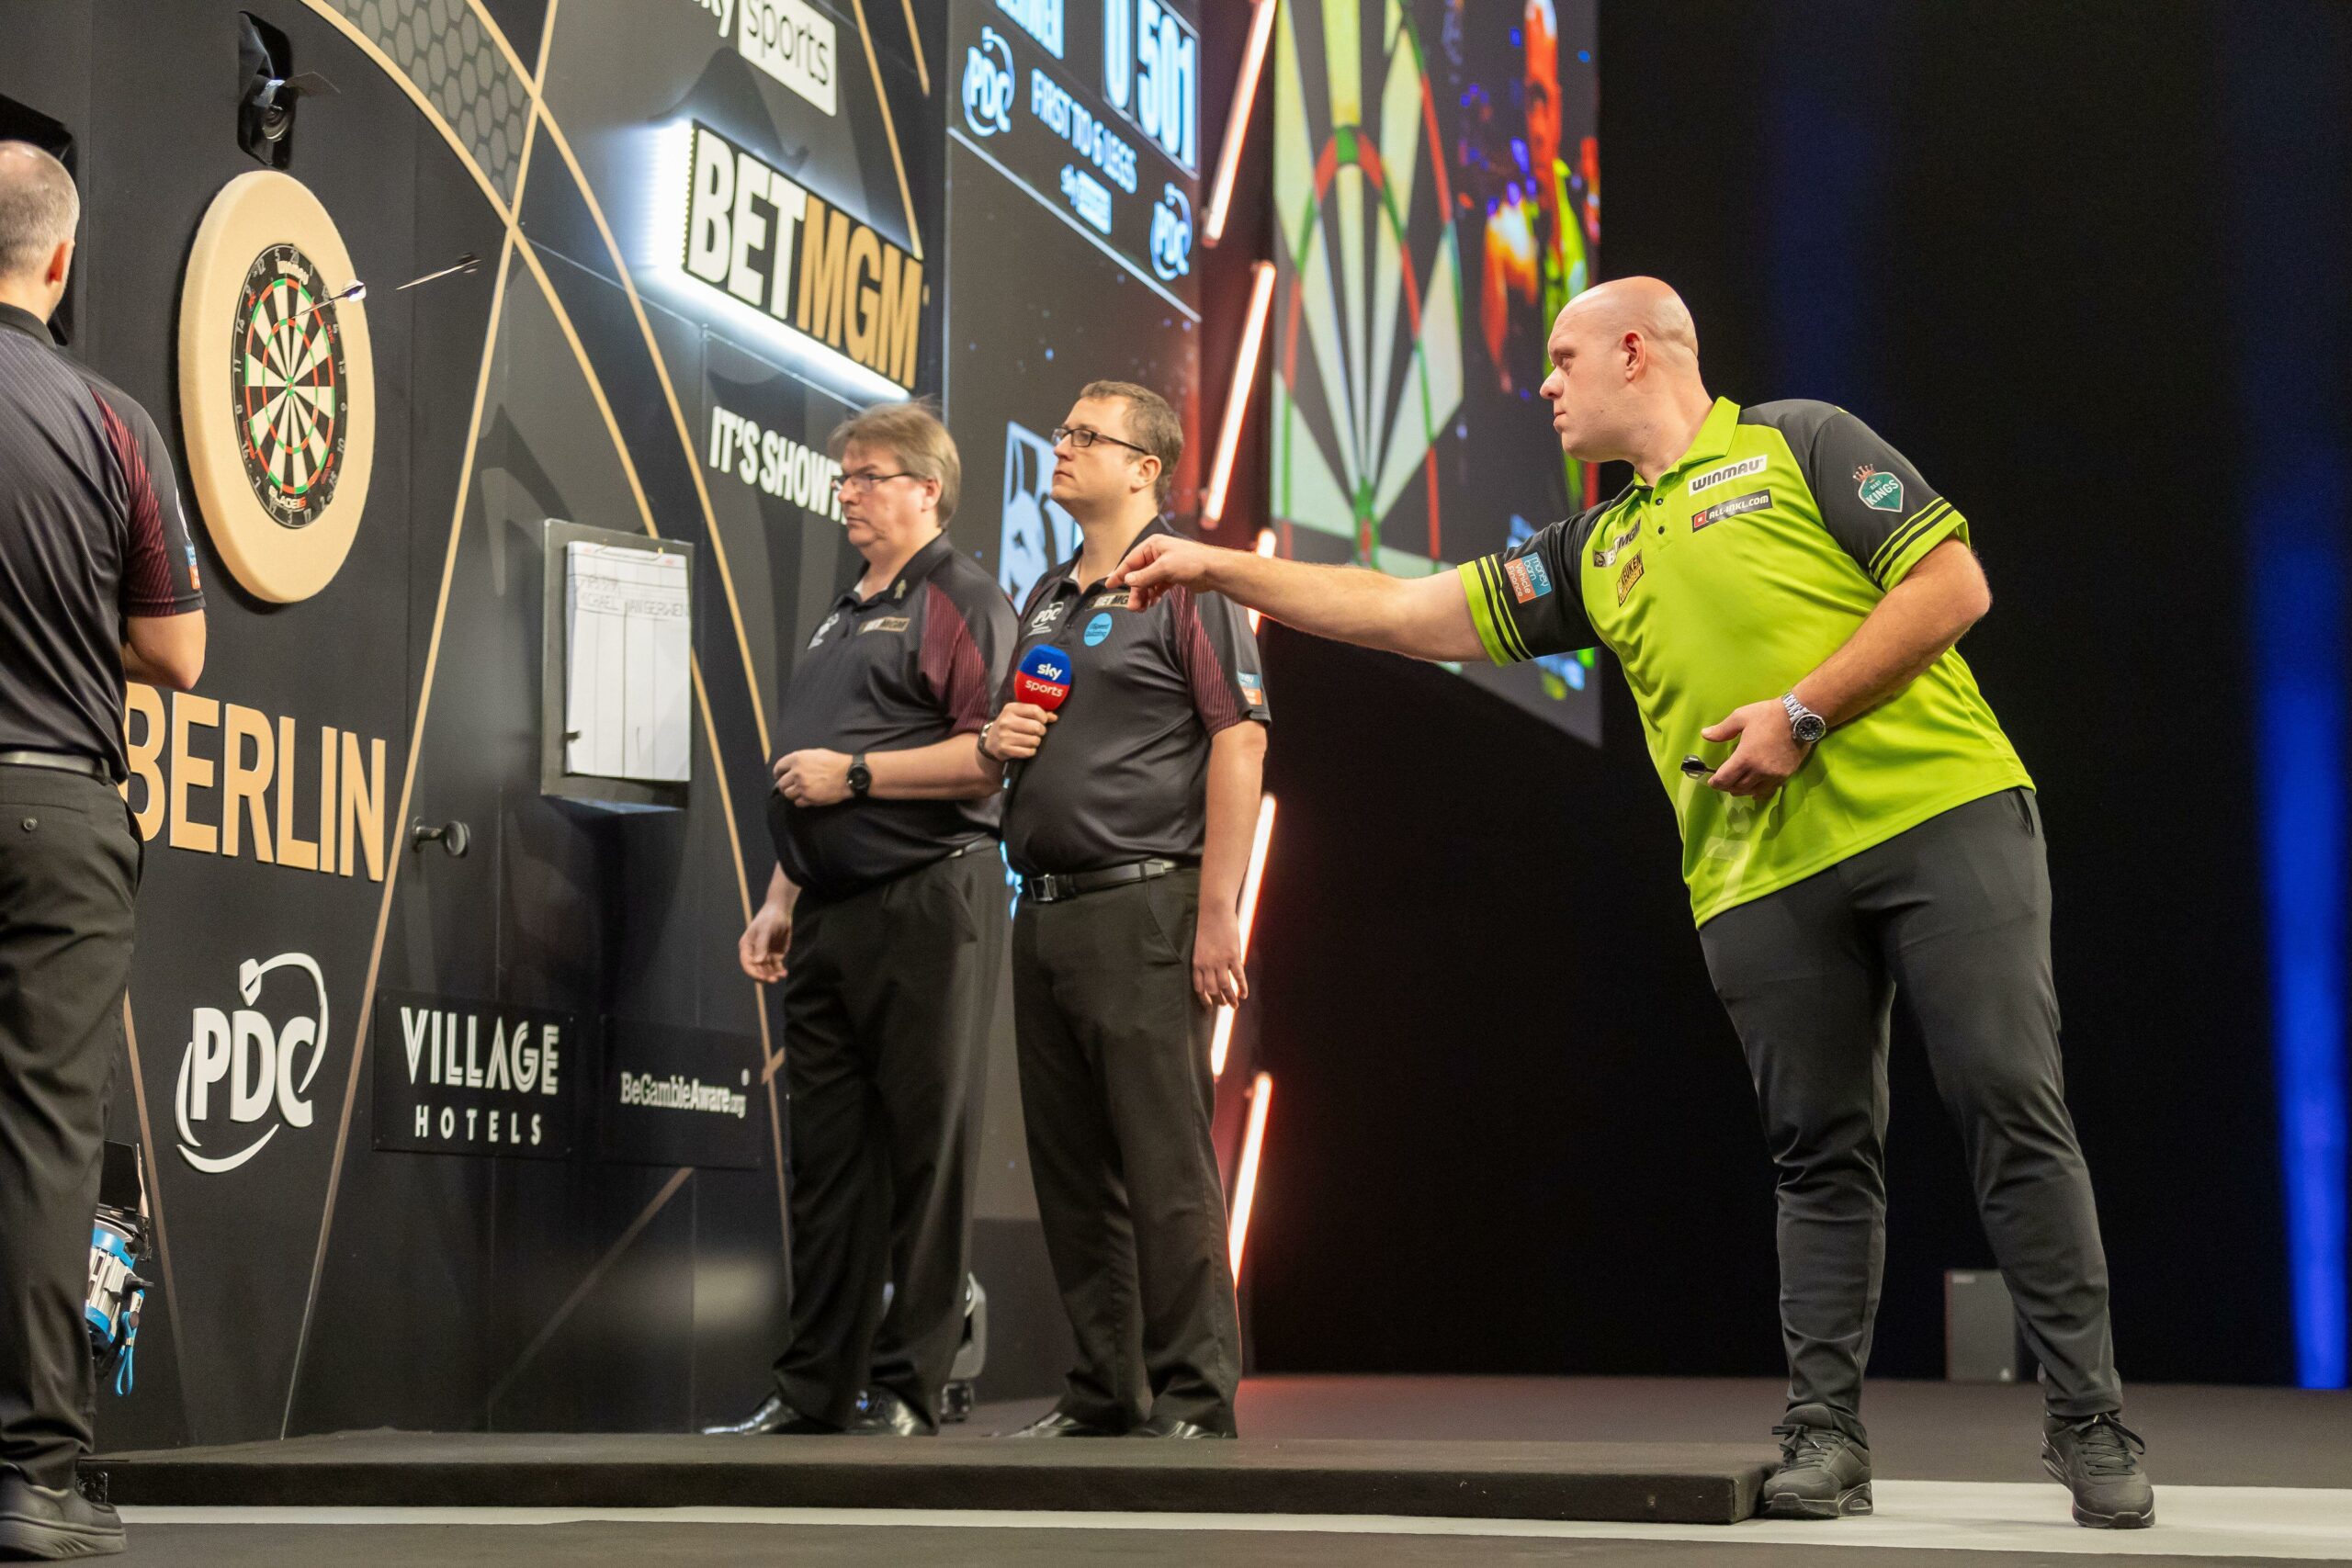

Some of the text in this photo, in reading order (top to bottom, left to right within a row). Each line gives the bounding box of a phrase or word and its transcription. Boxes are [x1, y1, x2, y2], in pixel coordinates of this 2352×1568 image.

[746, 0, 830, 86] sports
[708, 405, 848, 526] IT'S SHOWT
[1709, 494, 1770, 520] ALL-INKL.COM
[1865, 479, 1899, 506] KINGS
[1507, 565, 1524, 597] Finance
[1515, 563, 1531, 594] Vehicle
[1024, 679, 1064, 698] sports
[1036, 662, 1063, 682] sky
[124, 682, 387, 883] BERLIN
[189, 1007, 318, 1128] PDC
[400, 1007, 560, 1096] VILLAGE
[415, 1104, 543, 1146] HOTELS
